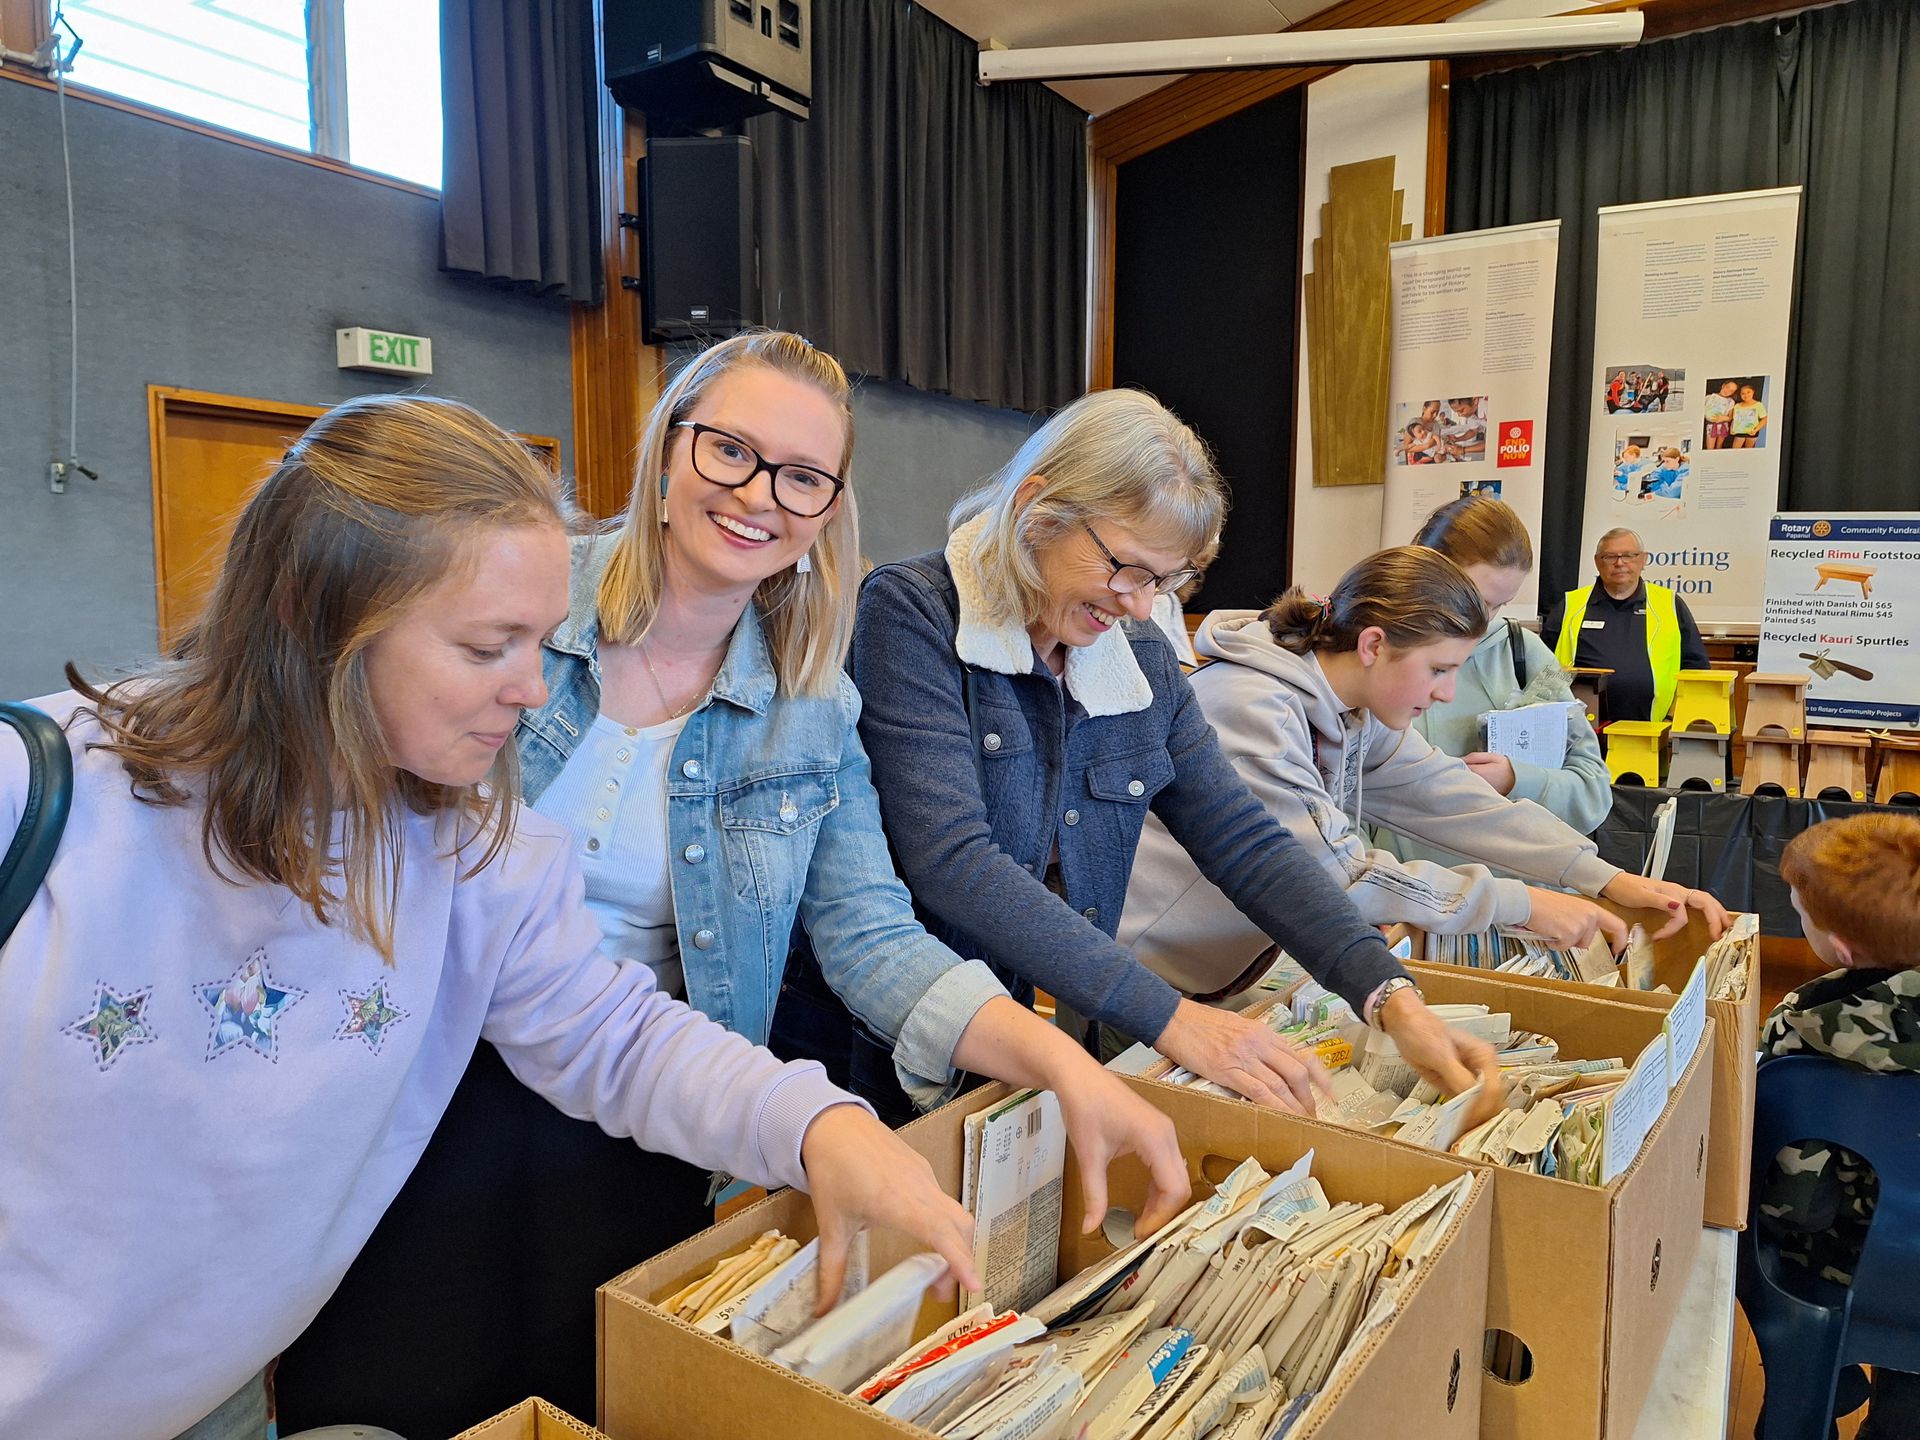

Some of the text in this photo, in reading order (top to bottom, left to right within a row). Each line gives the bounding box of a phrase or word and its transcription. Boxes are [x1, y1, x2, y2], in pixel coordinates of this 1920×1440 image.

[370, 334, 420, 368] EXIT
[1505, 438, 1526, 446] END
[1500, 444, 1530, 454] POLIO
[1503, 452, 1527, 460] NOW
[1781, 524, 1811, 534] Rotary
[1841, 526, 1887, 536] Community
[1770, 549, 1825, 560] Recycled
[1827, 549, 1860, 559] Rimu
[1766, 599, 1803, 607] Finished
[1860, 601, 1873, 609] Oil
[1765, 608, 1813, 616] Unfinished
[1815, 609, 1849, 617] Natural
[1850, 610, 1874, 618] Rimu
[1800, 617, 1817, 625] $45
[1763, 632, 1909, 647] Recycled Kauri Spurtles
[1818, 706, 1838, 714] Rotary
[1839, 707, 1875, 716] Community
[1876, 709, 1902, 717] Projects
